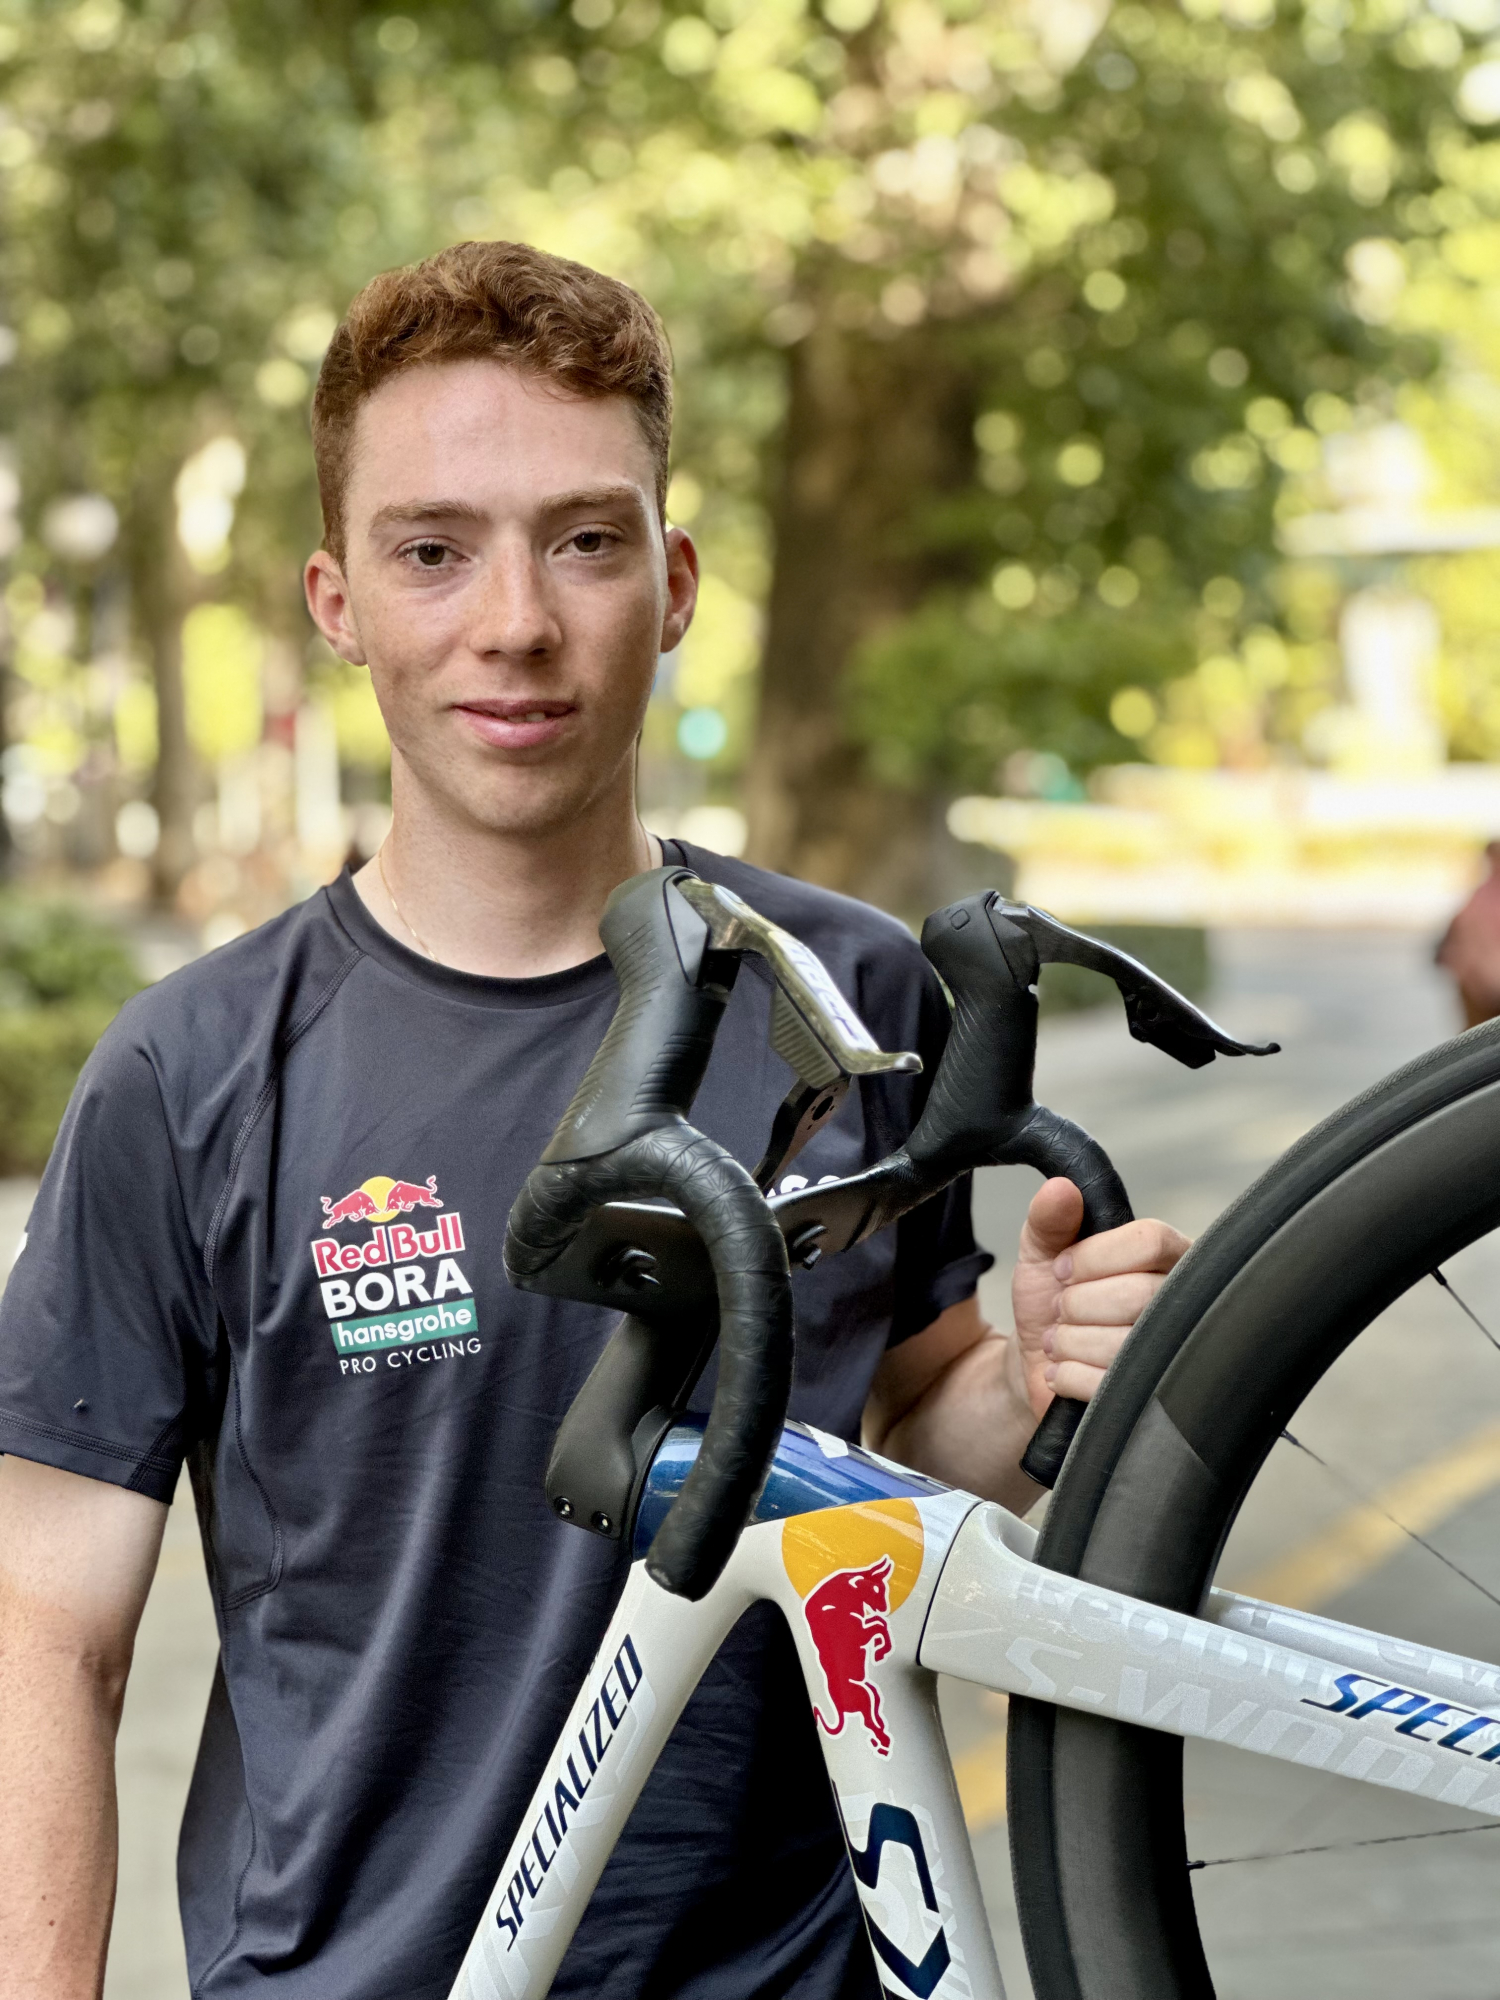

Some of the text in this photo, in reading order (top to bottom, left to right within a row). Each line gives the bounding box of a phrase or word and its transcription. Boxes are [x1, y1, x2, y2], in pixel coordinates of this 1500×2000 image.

[321, 1259, 473, 1318] BORA
[338, 1306, 471, 1347] hansgrohe
[340, 1338, 481, 1375] PRO CYCLING
[496, 1634, 643, 1952] SPECIALIZED
